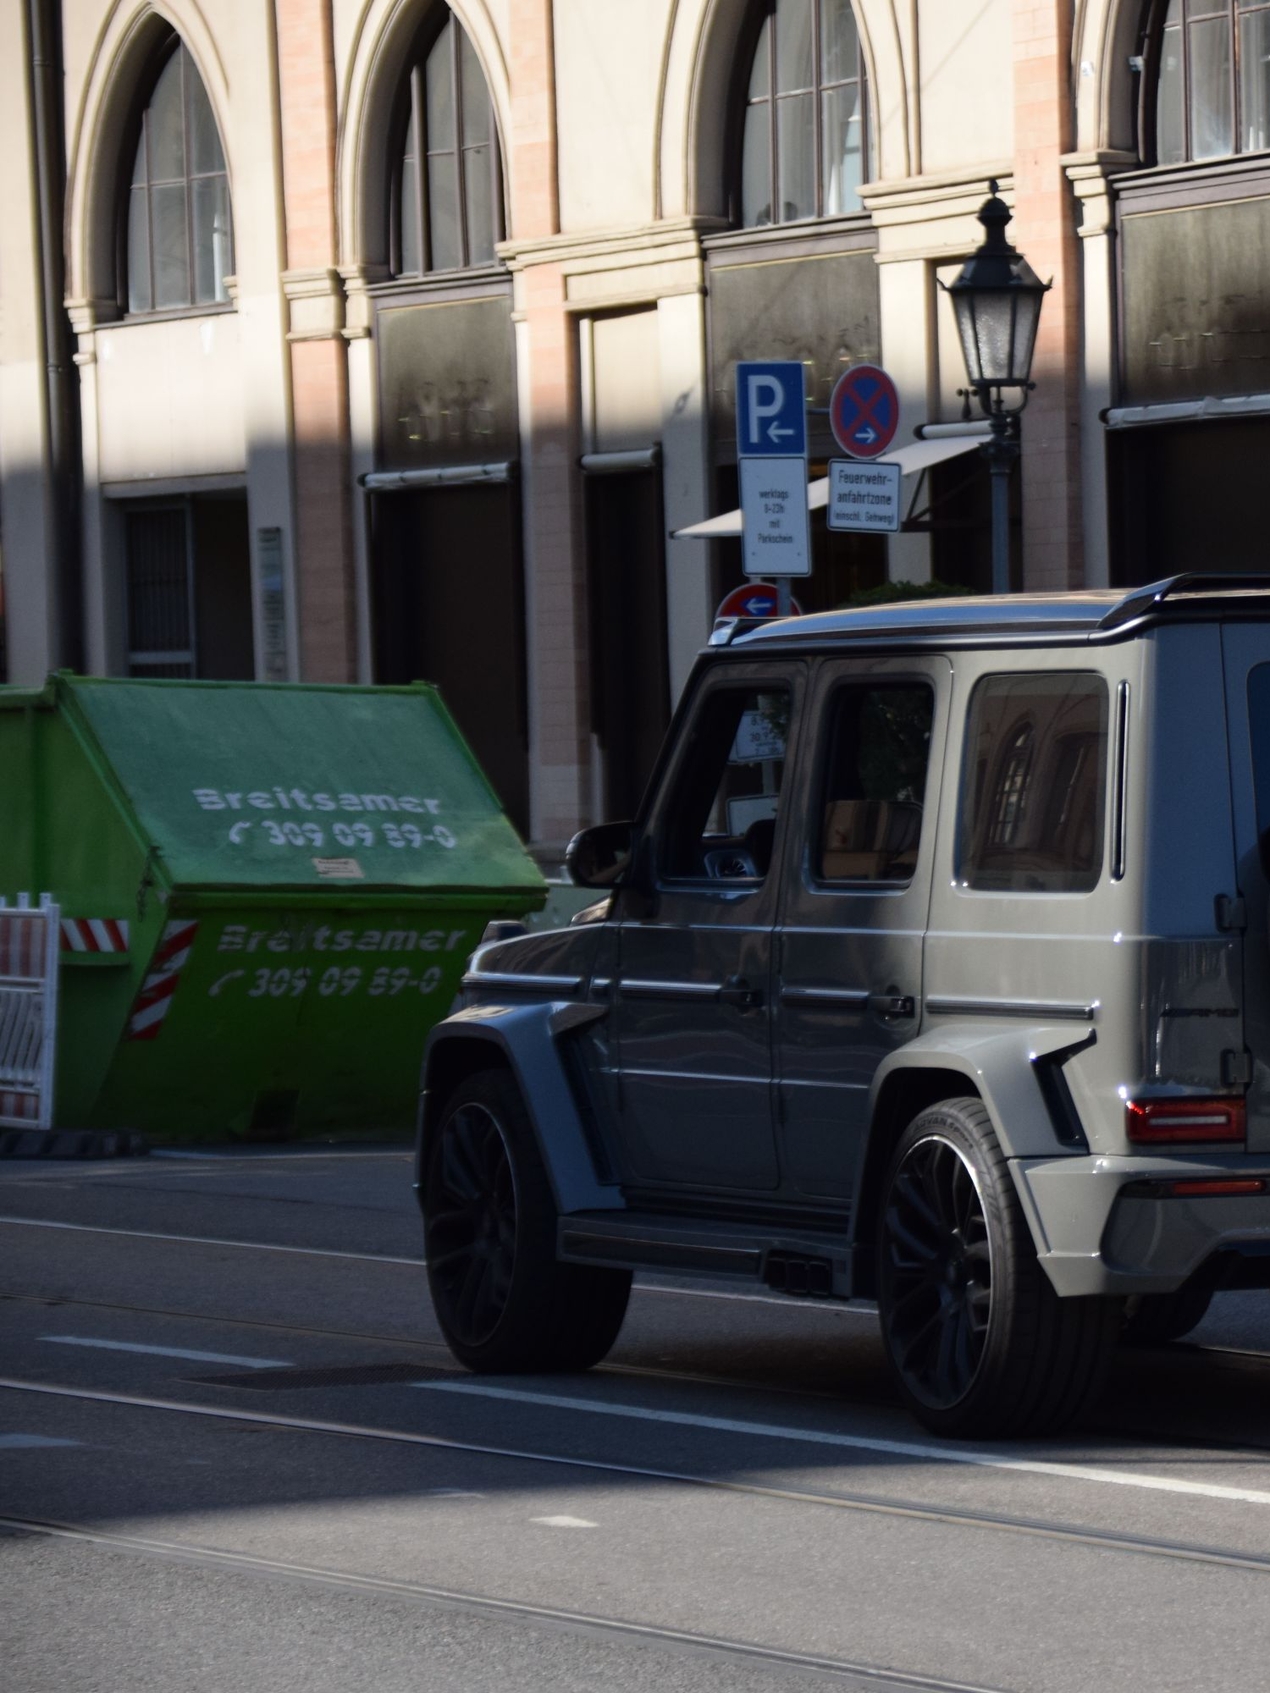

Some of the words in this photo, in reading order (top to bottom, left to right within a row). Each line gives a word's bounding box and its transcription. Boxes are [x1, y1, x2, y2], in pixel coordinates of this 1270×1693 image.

[747, 374, 785, 444] P
[838, 469, 894, 487] Feuerwehr-
[758, 488, 789, 501] werktags
[837, 490, 892, 506] anfahrtzone
[757, 532, 793, 544] Parkschein
[192, 787, 440, 815] Breitsamer
[261, 821, 324, 847] 309
[332, 822, 375, 848] 09
[381, 823, 457, 849] 89-0
[217, 924, 468, 954] Breitsamer
[247, 967, 312, 997] 309
[319, 966, 363, 997] 09
